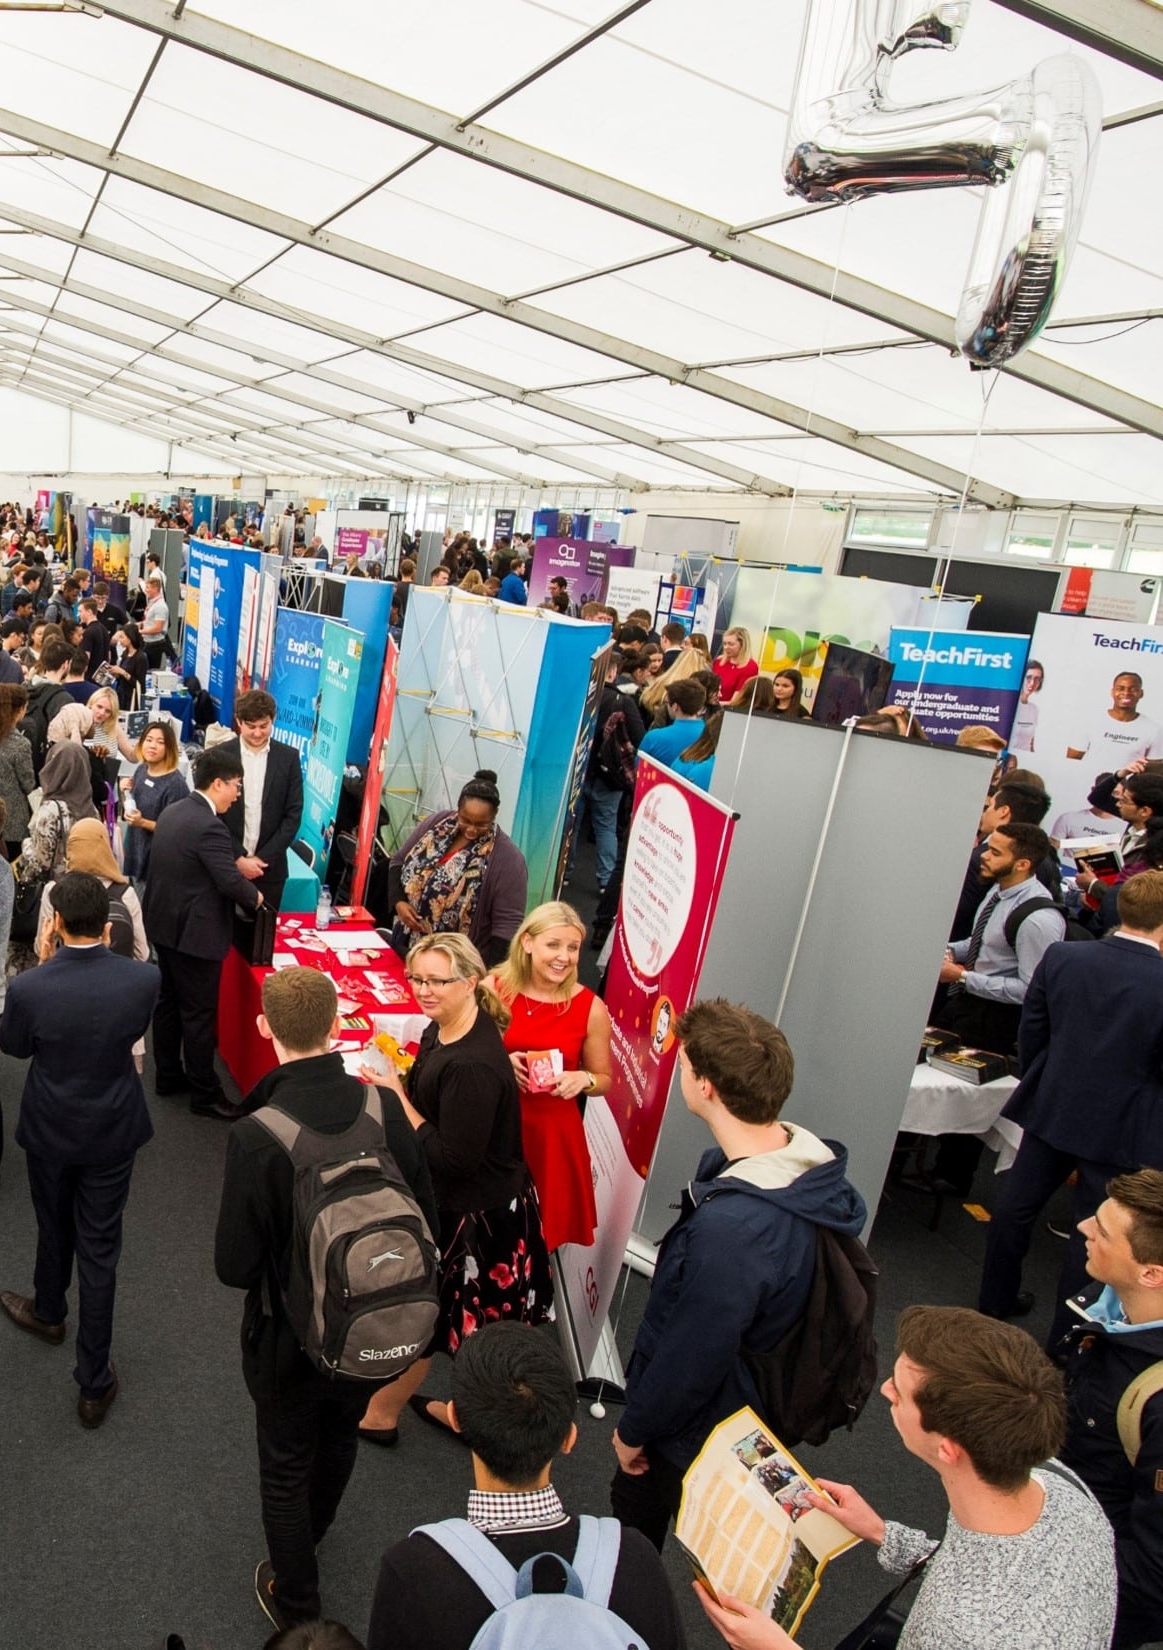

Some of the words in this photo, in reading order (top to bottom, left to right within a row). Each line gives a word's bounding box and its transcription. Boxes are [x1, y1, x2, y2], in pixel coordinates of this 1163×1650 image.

[900, 642, 1013, 669] TeachFirst
[895, 689, 922, 702] Apply
[924, 692, 943, 701] now
[944, 692, 958, 701] for
[981, 705, 999, 714] and
[935, 711, 999, 722] opportunities
